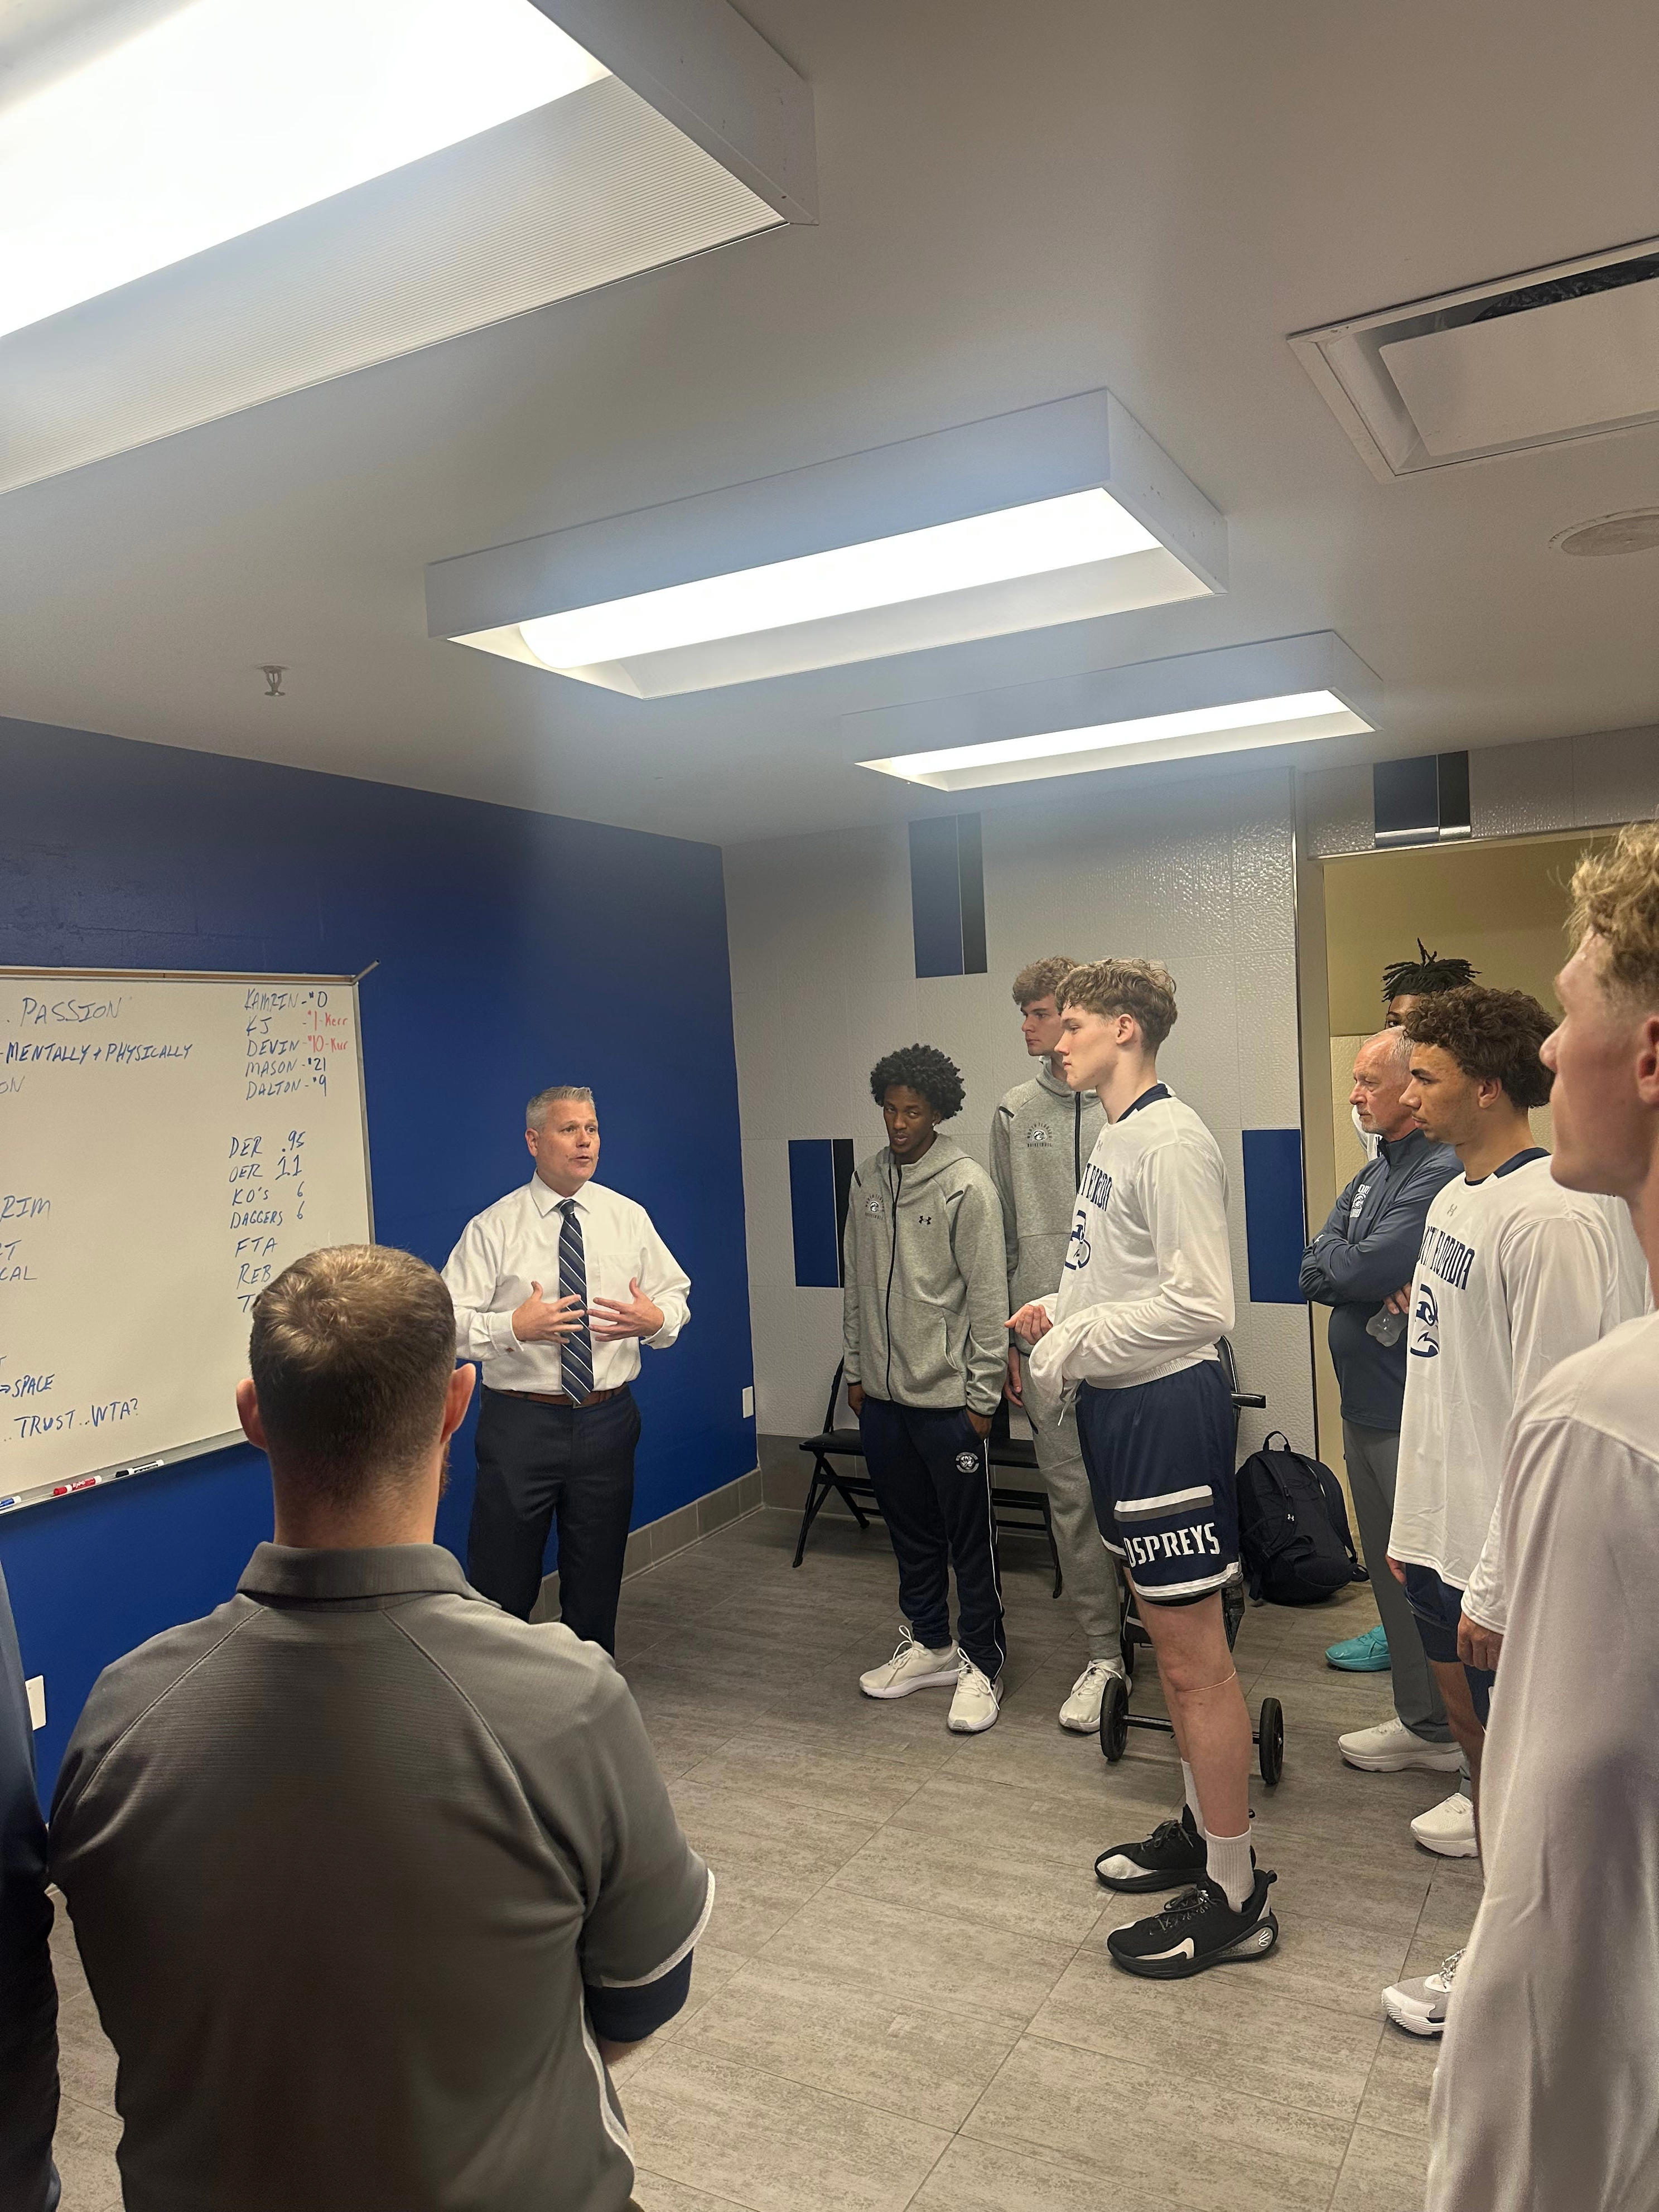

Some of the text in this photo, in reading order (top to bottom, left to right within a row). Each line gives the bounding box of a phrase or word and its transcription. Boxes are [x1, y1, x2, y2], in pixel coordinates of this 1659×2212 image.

[21, 997, 122, 1026] PASSION
[246, 1015, 272, 1036] KJ
[105, 1041, 192, 1064] PHYSICALLY
[247, 1040, 300, 1057] DEVIN
[245, 1059, 297, 1077] MASON
[246, 1079, 301, 1100] DALTON
[229, 1136, 263, 1158] DER
[229, 1163, 264, 1182] OER
[297, 1181, 304, 1197] 6
[0, 1195, 50, 1222] RIM
[230, 1201, 304, 1229] DAGGERS 6
[235, 1237, 278, 1257] FTA
[237, 1263, 271, 1289] REB
[12, 1374, 55, 1397] SPACE
[1123, 1522, 1220, 1567] OSPREYS
